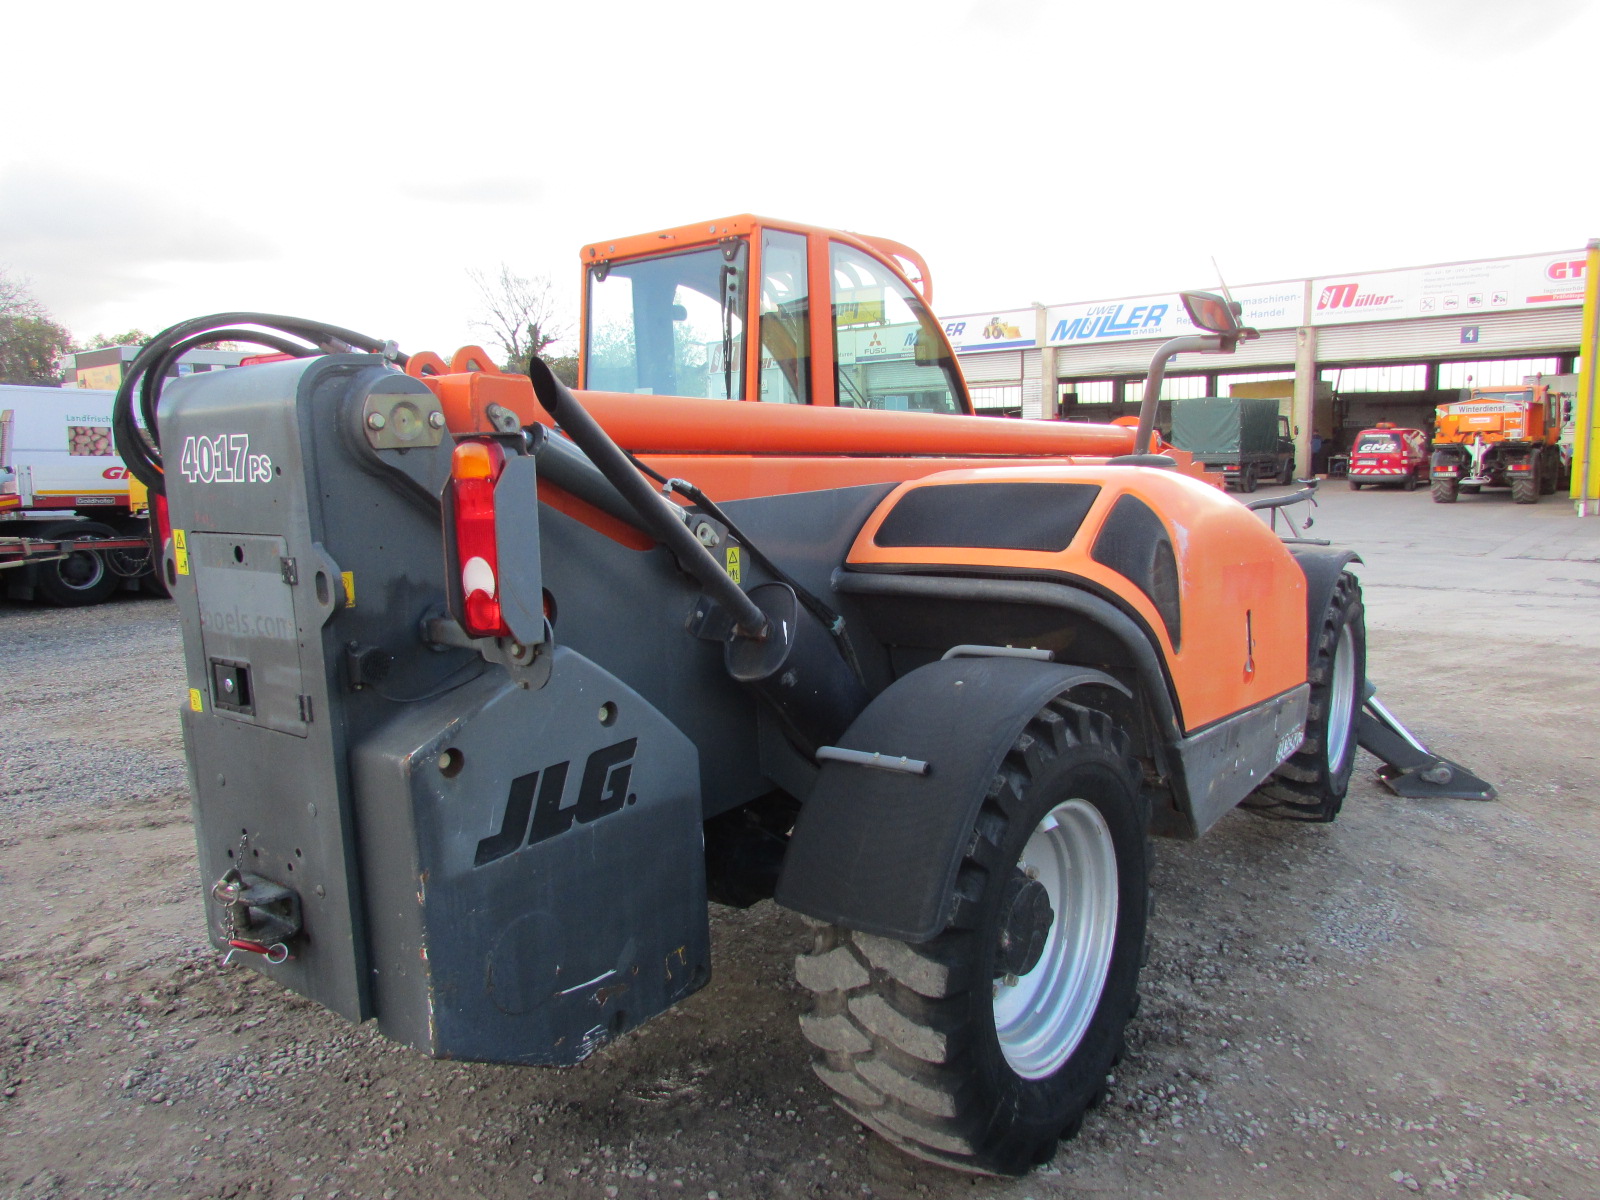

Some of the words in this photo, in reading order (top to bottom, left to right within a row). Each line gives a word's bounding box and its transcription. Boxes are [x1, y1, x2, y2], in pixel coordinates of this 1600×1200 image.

[1087, 305, 1116, 317] UWE
[1465, 330, 1474, 341] 4
[864, 347, 887, 355] FUSO
[1458, 404, 1506, 413] Winterdienst
[66, 414, 113, 423] Landfrisch
[1360, 443, 1397, 452] GMS
